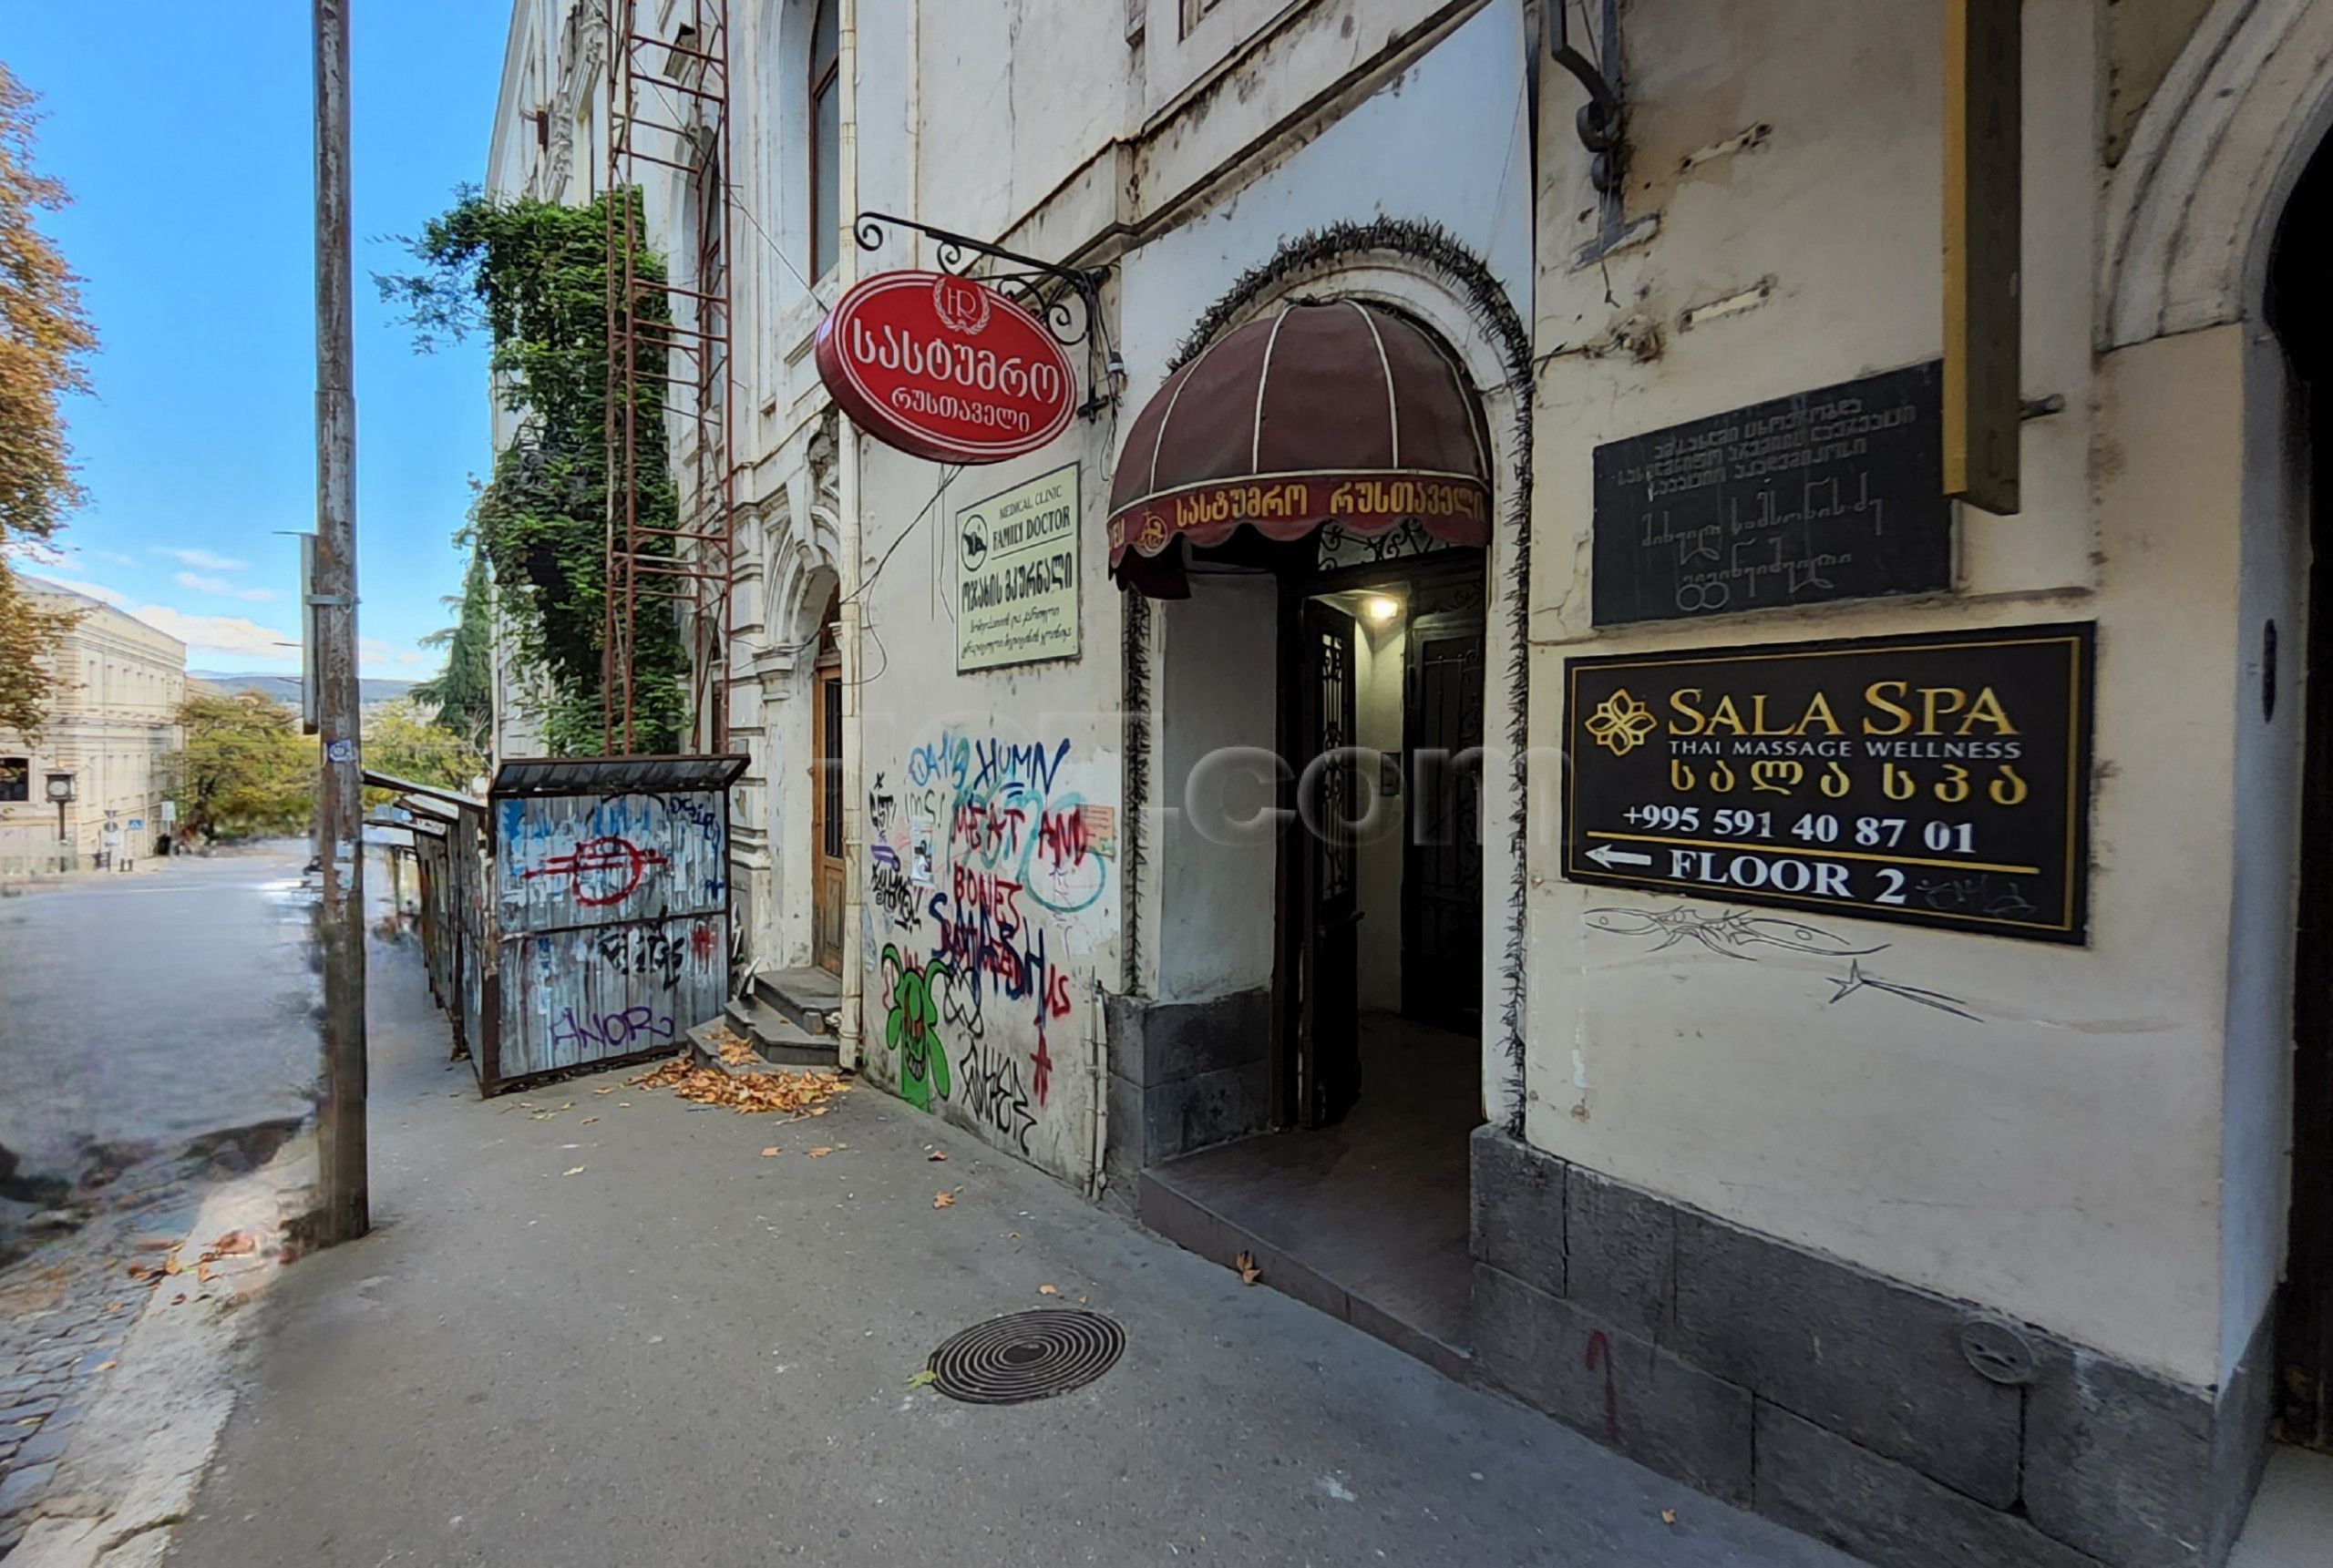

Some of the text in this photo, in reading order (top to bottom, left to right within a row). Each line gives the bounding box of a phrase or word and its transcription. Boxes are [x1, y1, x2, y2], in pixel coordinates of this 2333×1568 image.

[853, 317, 1060, 405] სასტუმრო
[891, 386, 1031, 433] რუსთაველი
[1034, 484, 1063, 506] CLINIC
[1176, 480, 1487, 528] სასტუმრო რუსთაველი
[992, 521, 1023, 551] FAMILY
[1026, 505, 1071, 540] DOCTOR
[1669, 740, 2022, 760] THAI MASSAGE WELLNESS
[1670, 760, 2028, 805] სალა სპა
[1622, 804, 1977, 854] +995 591 40 87 01
[1667, 848, 1855, 899] FLOOR
[1874, 868, 1906, 905] 2
